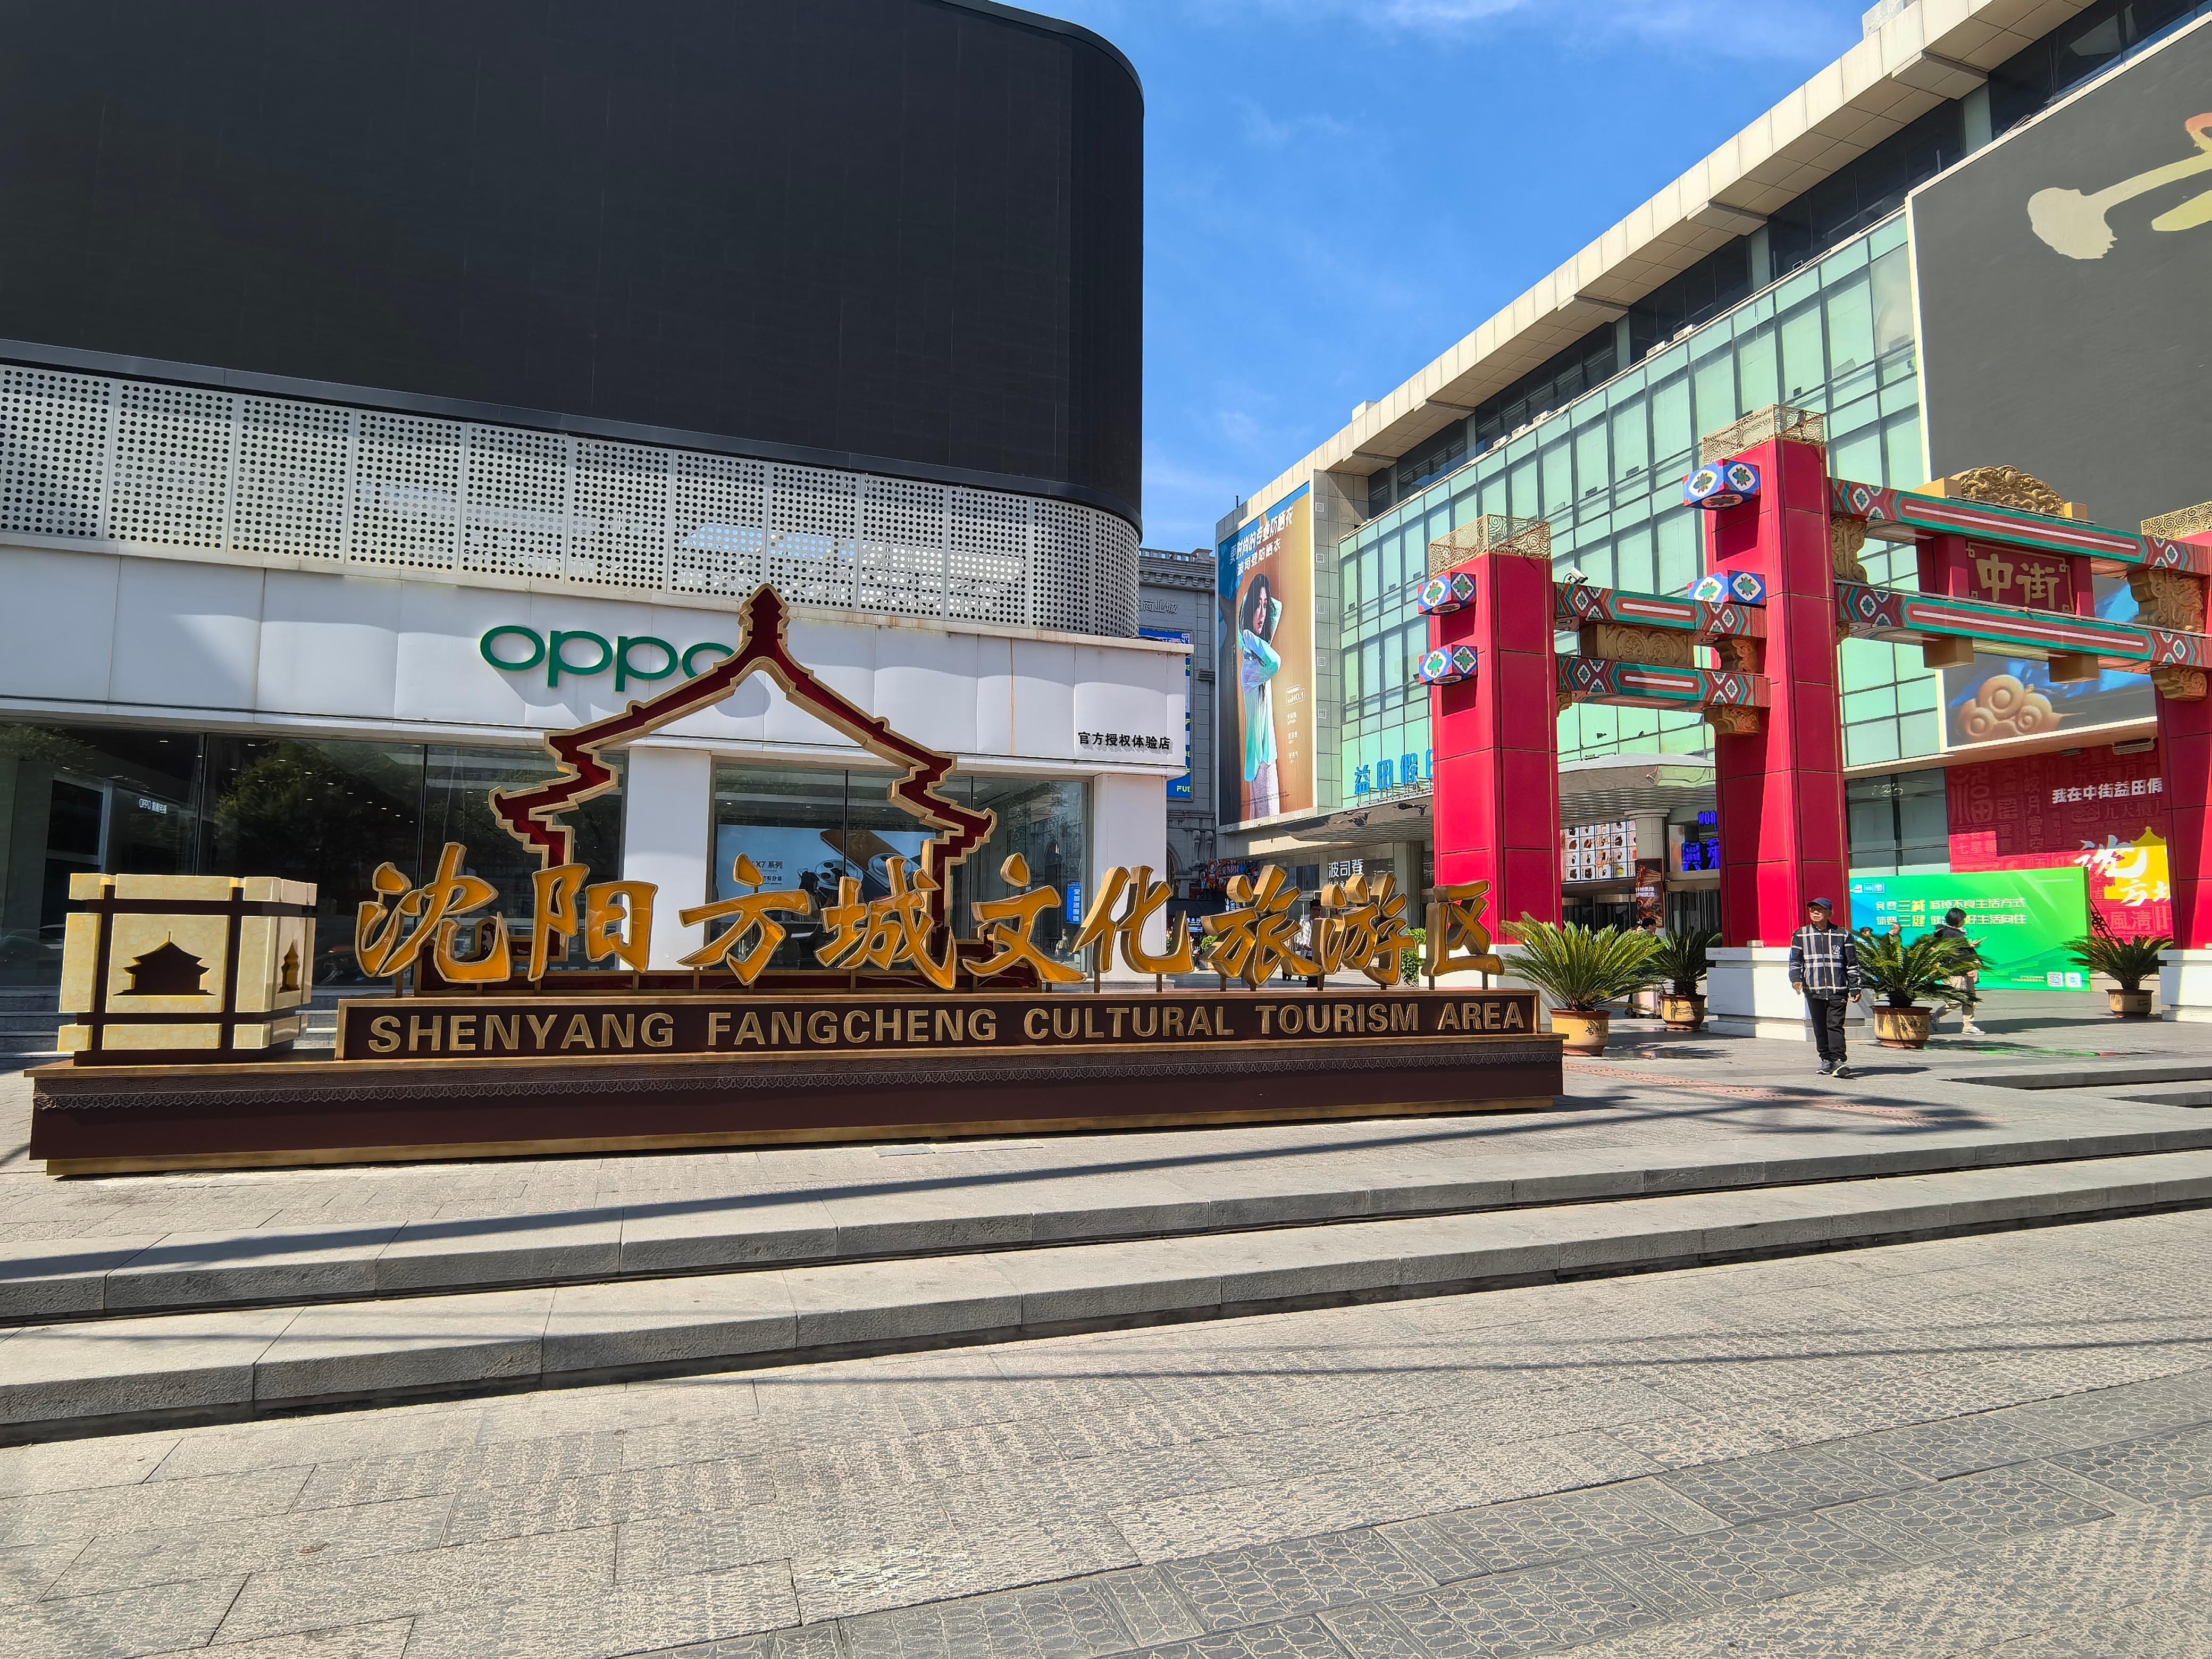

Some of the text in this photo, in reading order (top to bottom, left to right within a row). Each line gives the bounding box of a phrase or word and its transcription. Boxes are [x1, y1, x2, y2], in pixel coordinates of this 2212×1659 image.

[1237, 537, 1281, 576] 波司登防晒衣
[1975, 553, 2060, 610] 中街
[1078, 732, 1170, 749] 官方授权体验店
[1328, 859, 1364, 878] 波司登
[355, 842, 1505, 990] 沈阳方城文化旅游区
[367, 1001, 1525, 1052] SHENYANG FANGCHENG CULTURAL TOURISM AREA
